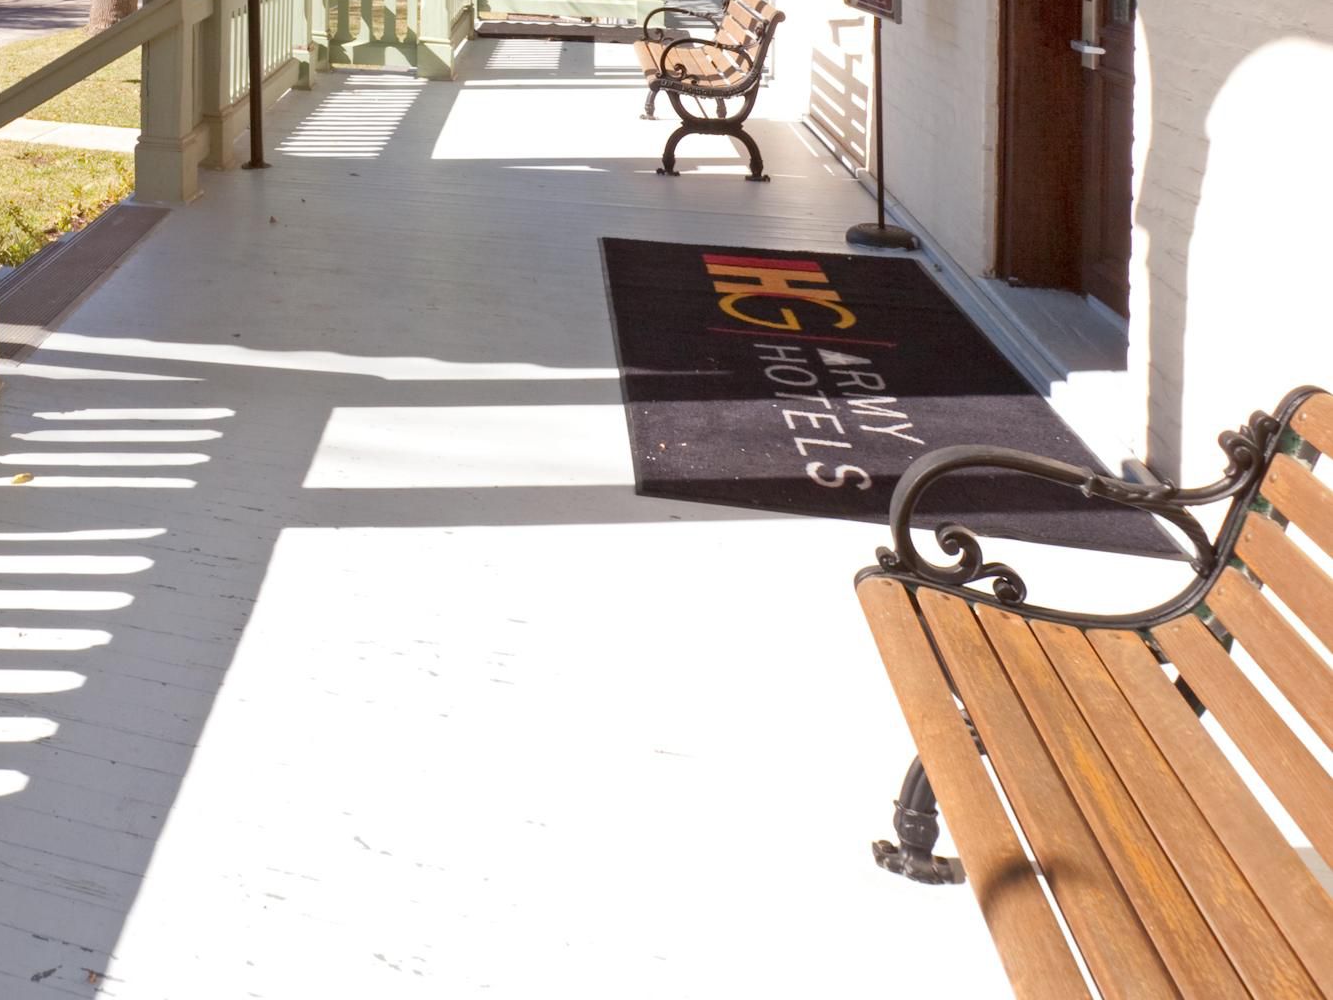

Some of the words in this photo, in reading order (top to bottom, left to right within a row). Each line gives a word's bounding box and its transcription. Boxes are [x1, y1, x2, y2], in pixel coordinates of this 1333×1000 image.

[702, 253, 857, 331] IHG
[753, 343, 872, 491] HOTELS
[816, 348, 926, 445] ARMY
